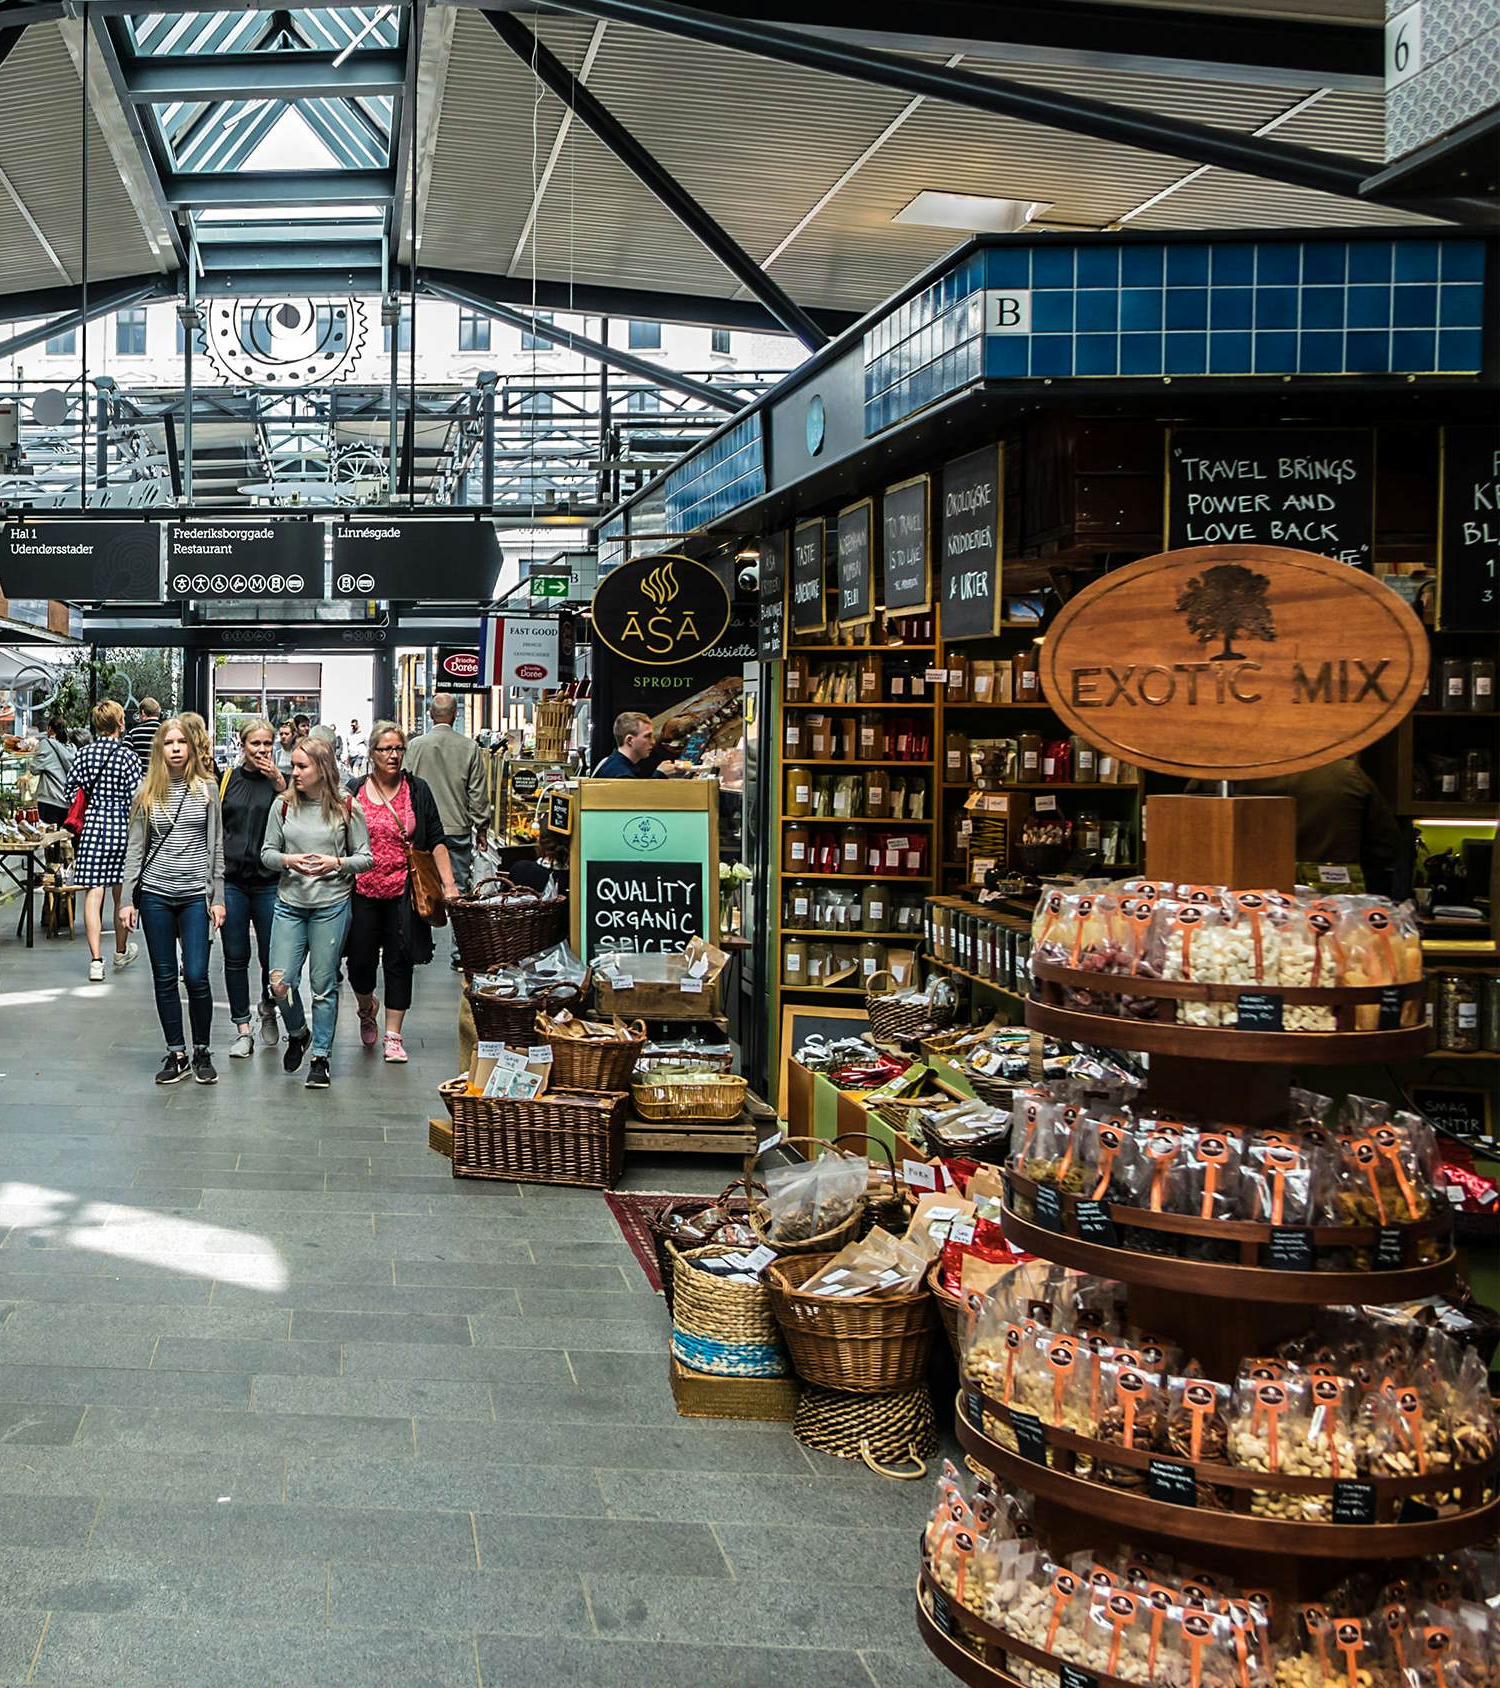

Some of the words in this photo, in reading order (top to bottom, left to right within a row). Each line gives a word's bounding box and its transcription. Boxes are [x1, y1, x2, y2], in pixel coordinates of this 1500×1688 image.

[1394, 22, 1410, 72] 6
[995, 297, 1021, 328] B
[1278, 455, 1357, 485] BRINGS
[1187, 493, 1271, 515] POWER
[1282, 493, 1337, 512] AND
[10, 528, 29, 539] Hal
[30, 528, 37, 539] 1
[173, 527, 275, 542] Frederiksborggade
[337, 527, 401, 542] Linnésgade
[1186, 522, 1257, 542] LOVE
[1270, 521, 1340, 542] BACK
[10, 543, 94, 556] Udendørsstader
[173, 543, 233, 555] Restaurant
[795, 543, 815, 567] TASTE
[960, 571, 989, 601] URTER
[509, 627, 529, 636] FAST
[532, 627, 558, 637] GOOD
[633, 676, 694, 688] SPRØDT
[1070, 660, 1263, 708] EXOTIC
[1291, 658, 1394, 705] MIX
[596, 876, 696, 905] QUALITY
[595, 908, 696, 934] ORGANIC
[1425, 1100, 1469, 1116] SMAG
